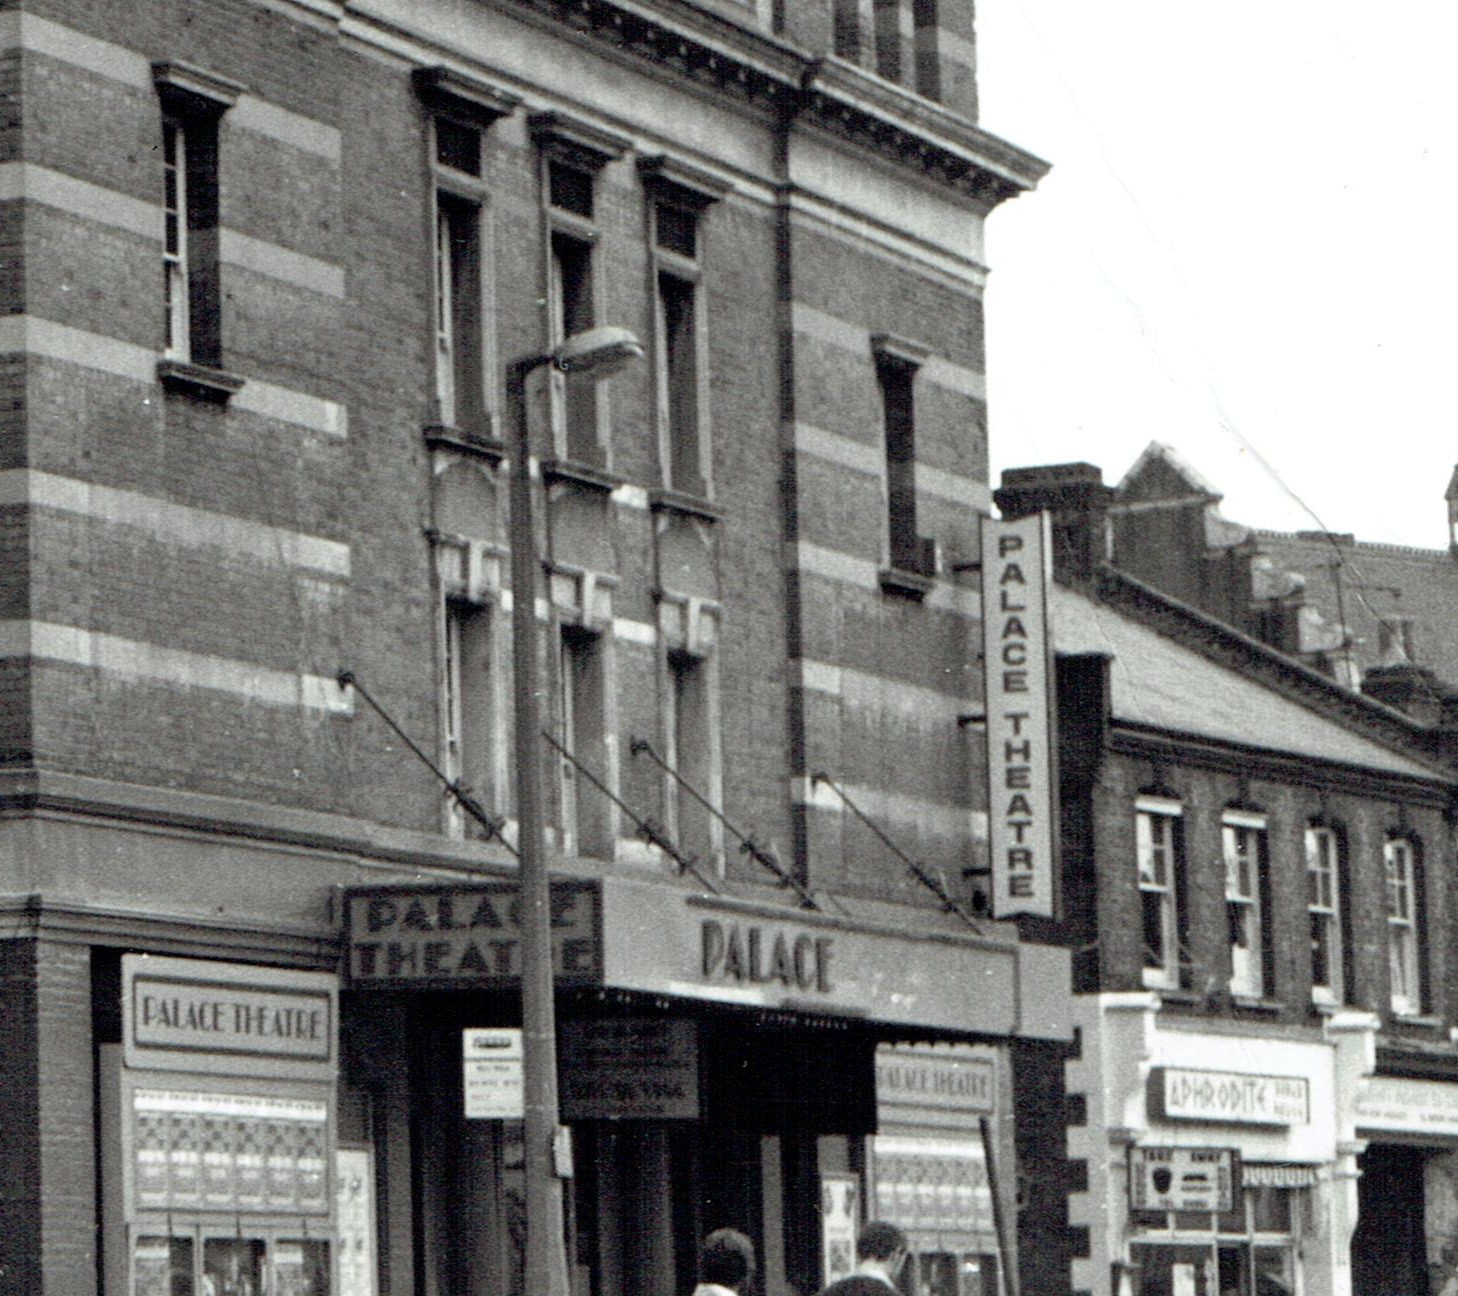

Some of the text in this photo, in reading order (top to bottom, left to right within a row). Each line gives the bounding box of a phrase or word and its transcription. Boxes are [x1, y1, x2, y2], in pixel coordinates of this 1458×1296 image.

[999, 534, 1035, 898] PALACE THEATRE
[354, 940, 593, 974] THEATE
[701, 919, 835, 993] PALACE
[142, 996, 322, 1041] PALACE THEATRE
